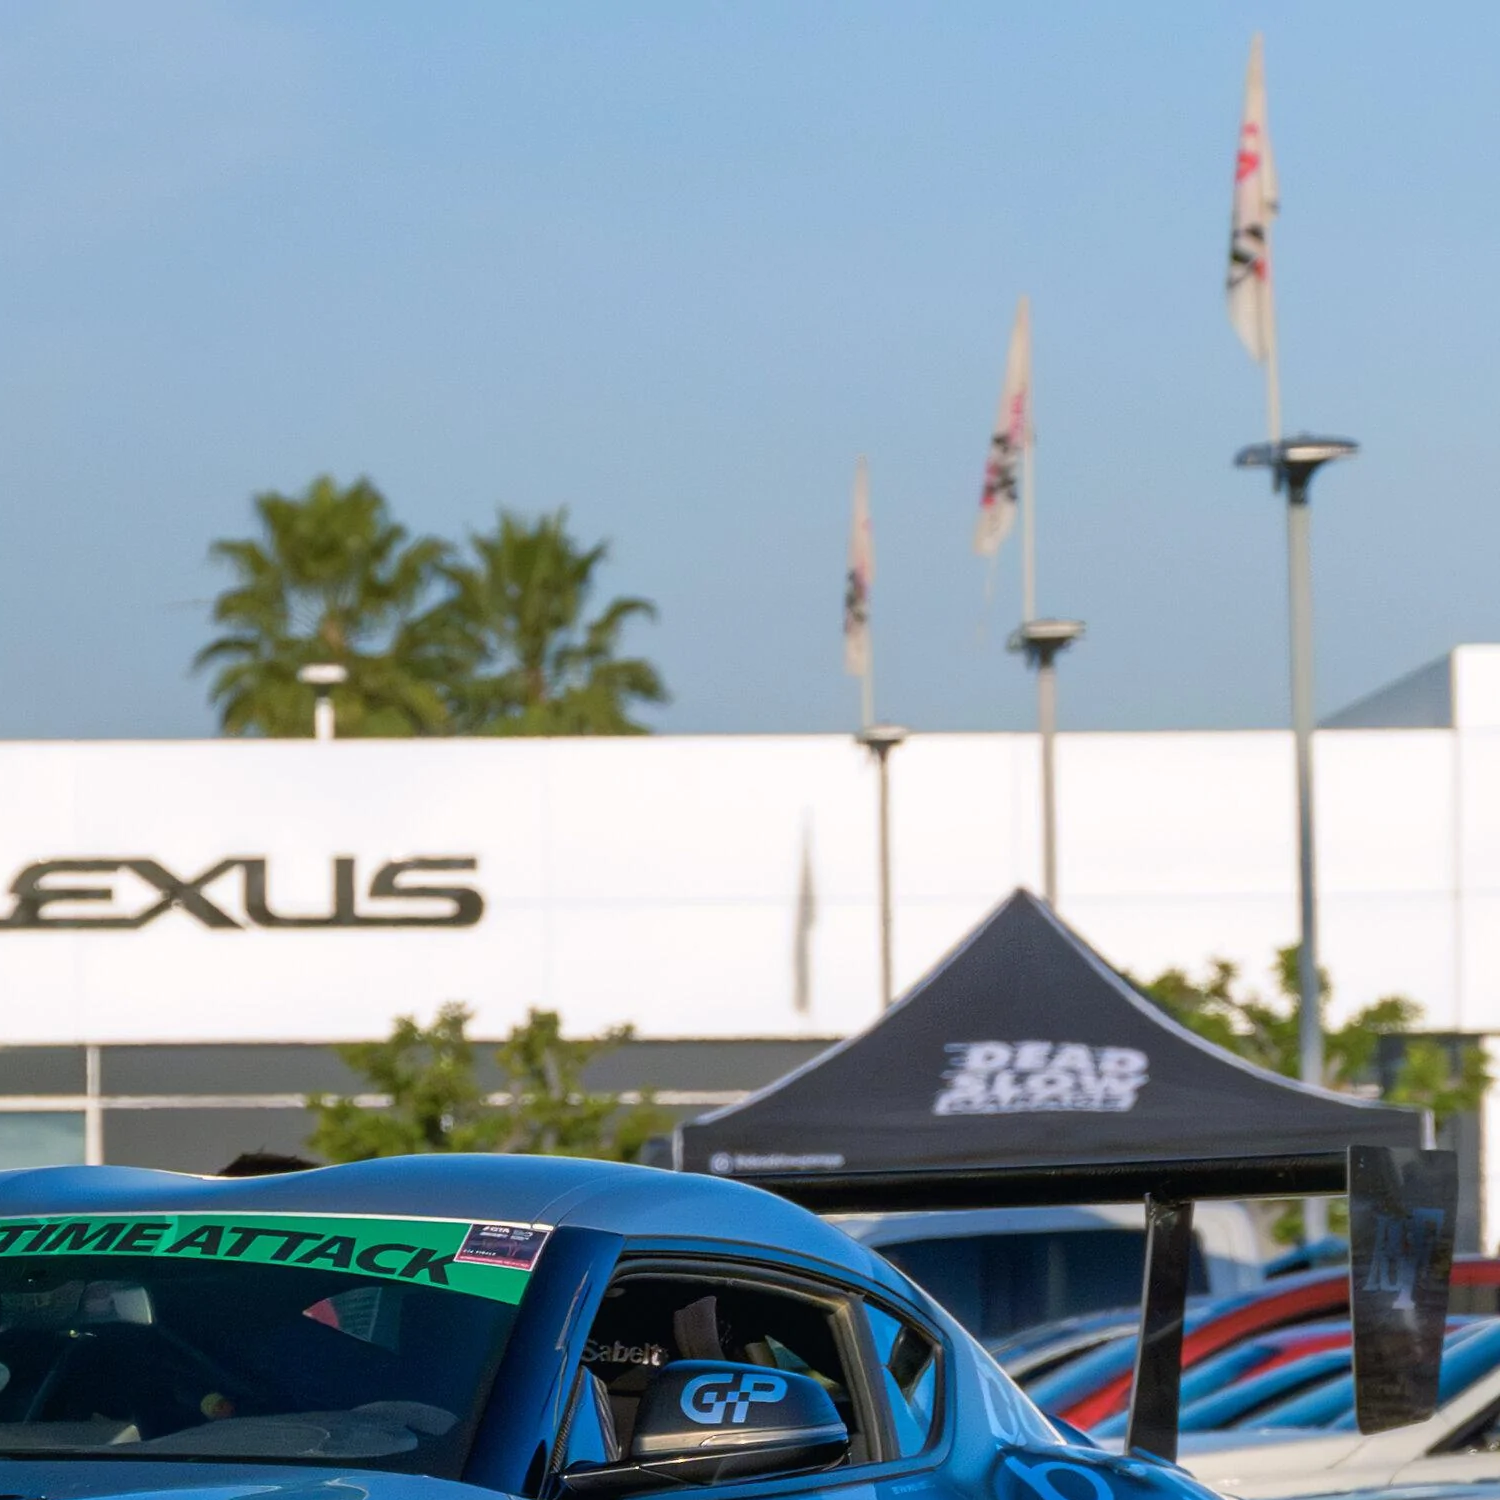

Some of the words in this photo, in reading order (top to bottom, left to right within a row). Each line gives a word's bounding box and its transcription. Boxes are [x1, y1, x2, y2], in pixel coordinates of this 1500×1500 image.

[962, 1040, 1148, 1076] DEAD
[946, 1070, 1148, 1101] SLOW
[165, 1224, 454, 1286] ATTACK
[581, 1339, 662, 1366] Sabelt
[680, 1373, 788, 1424] GP
